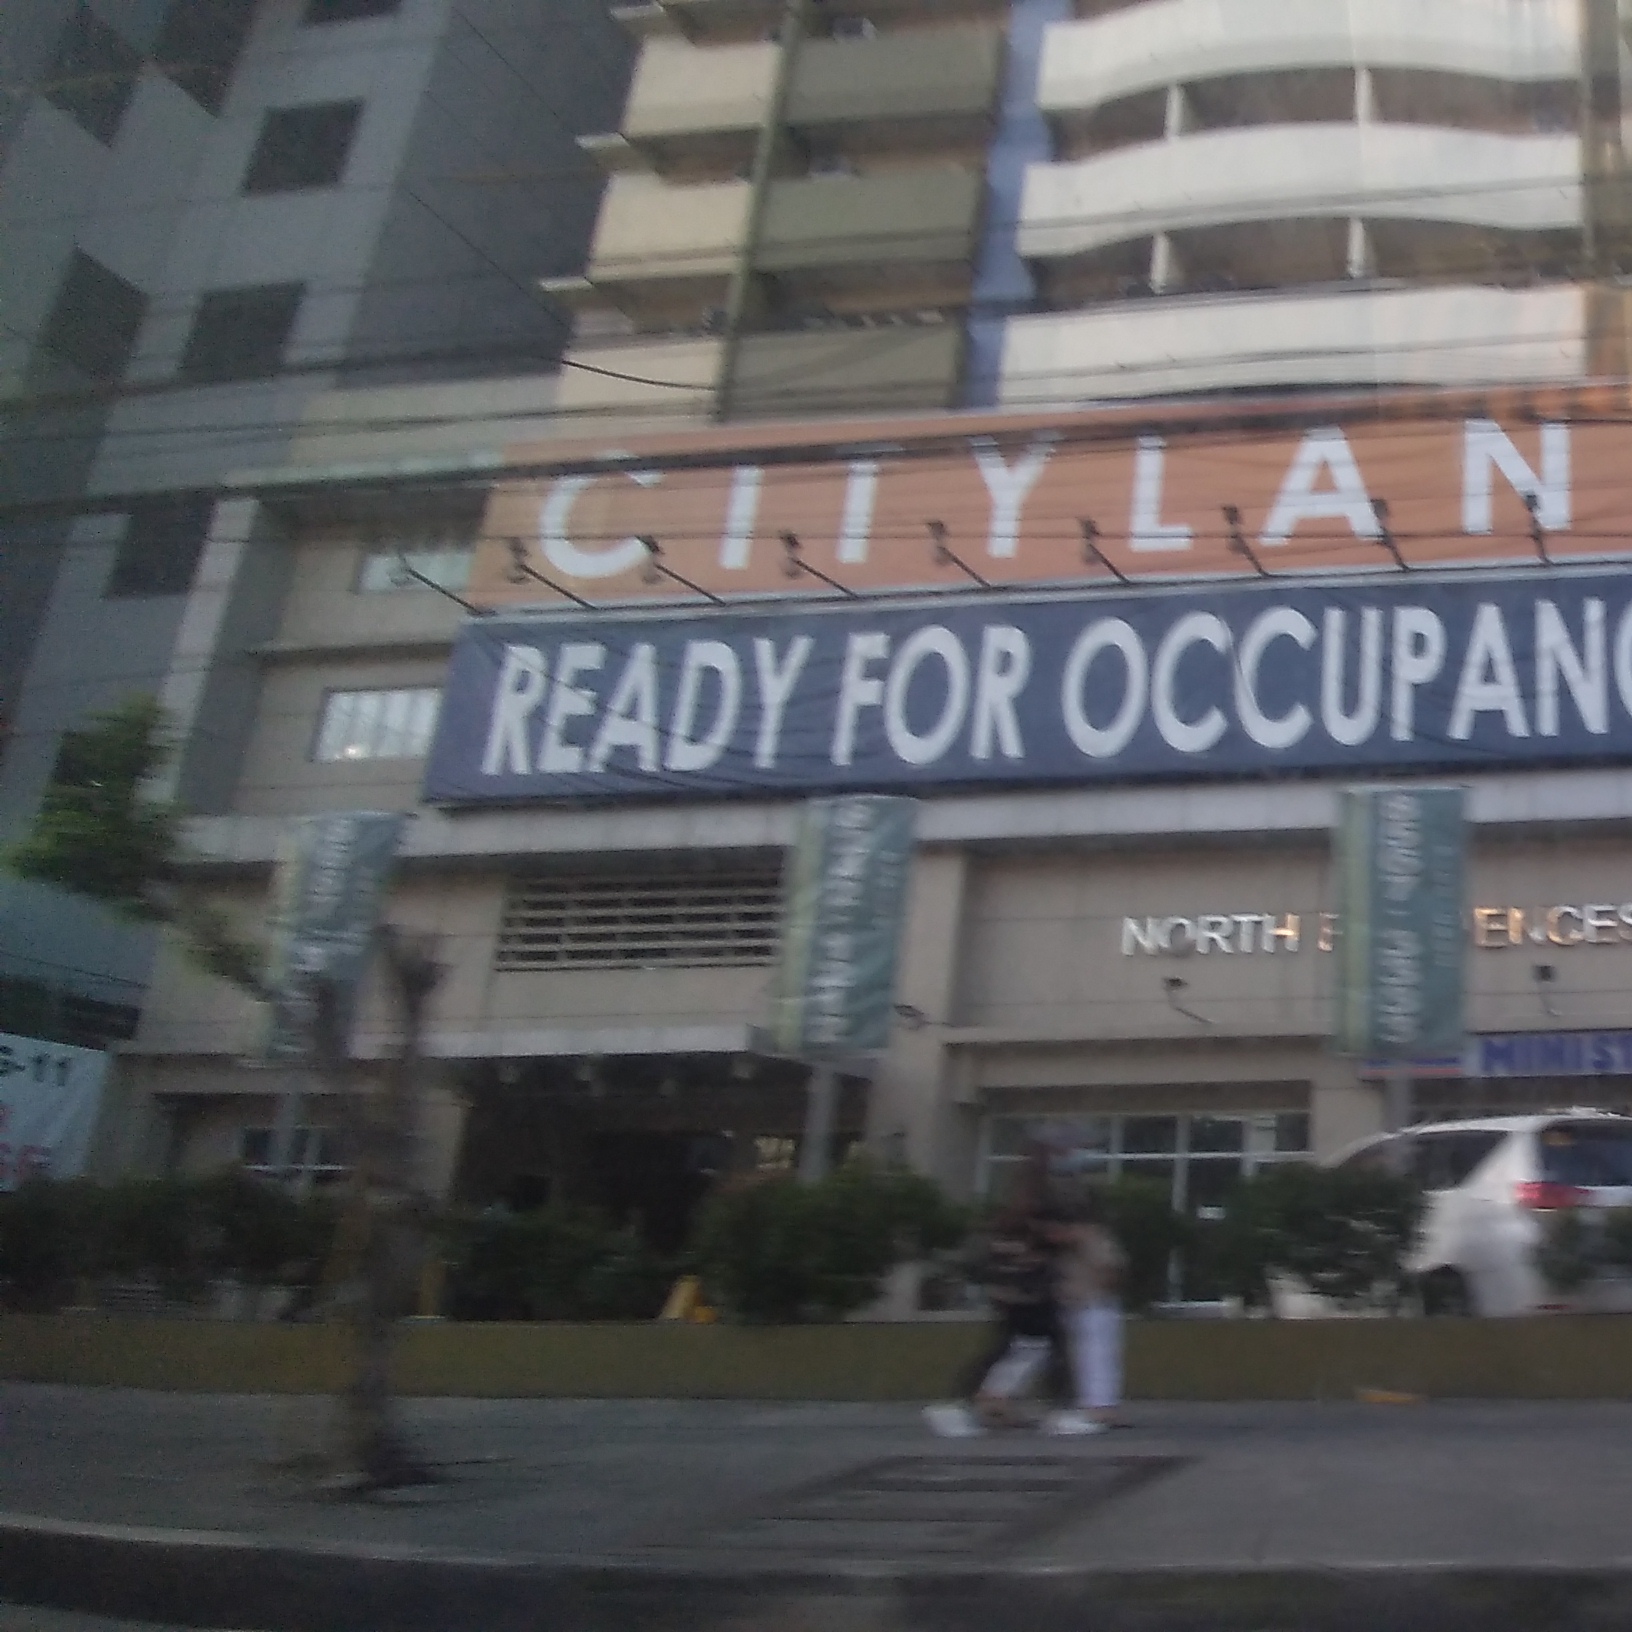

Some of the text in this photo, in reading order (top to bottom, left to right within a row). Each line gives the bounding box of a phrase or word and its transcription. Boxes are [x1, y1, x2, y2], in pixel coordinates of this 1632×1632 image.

[482, 634, 815, 776] READY
[830, 624, 1031, 766] FOR
[1121, 912, 1300, 957] NORTH
